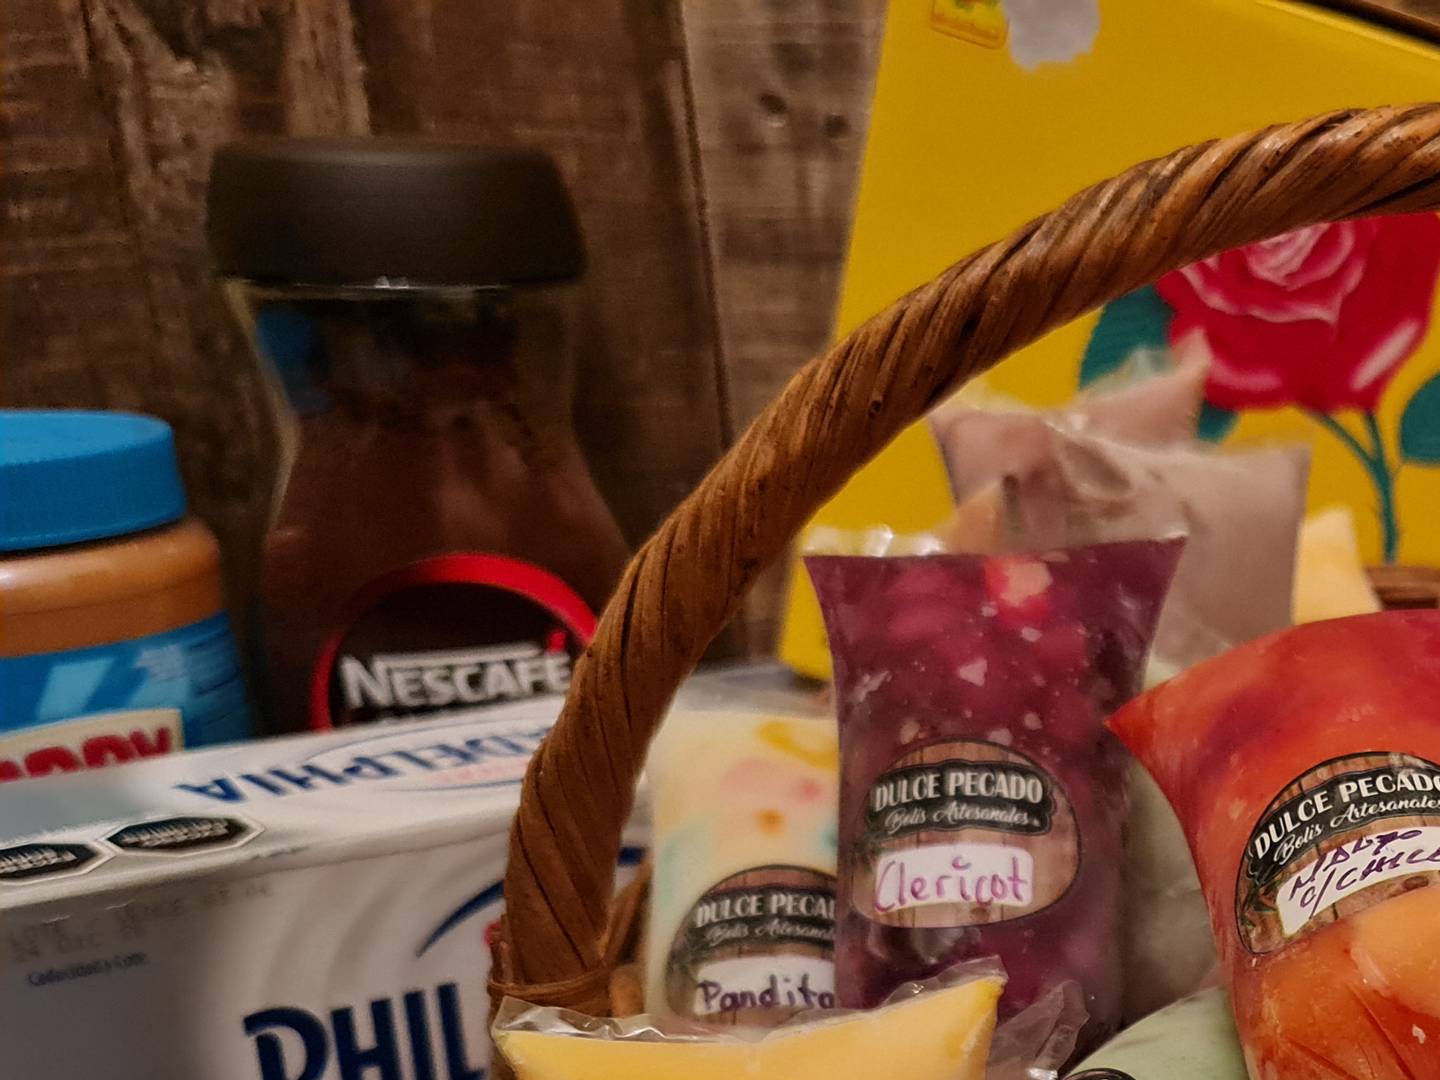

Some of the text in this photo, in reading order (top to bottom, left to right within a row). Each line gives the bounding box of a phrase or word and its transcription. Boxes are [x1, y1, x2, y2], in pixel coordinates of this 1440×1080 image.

[874, 771, 1044, 812] DULCE PECADO
[884, 800, 1030, 835] Bolis Artesanales
[1253, 789, 1333, 861] DULCE
[1272, 821, 1324, 866] Bolis
[695, 894, 764, 929] DULCE
